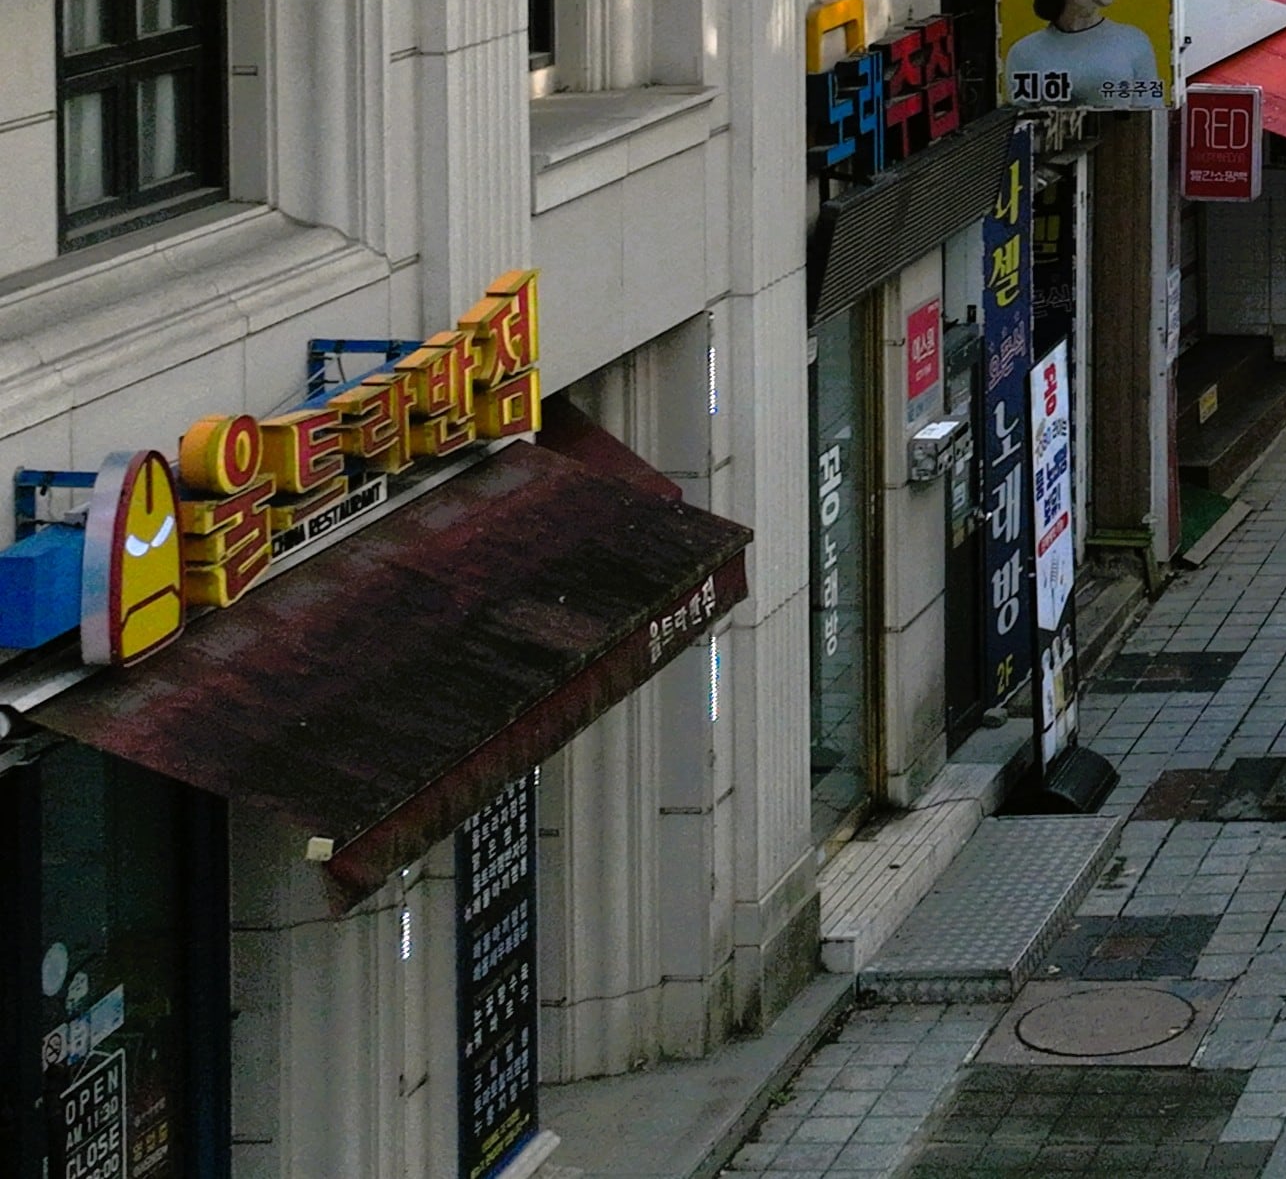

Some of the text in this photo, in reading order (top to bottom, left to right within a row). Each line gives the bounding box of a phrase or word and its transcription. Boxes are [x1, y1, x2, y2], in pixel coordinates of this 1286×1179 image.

[1012, 72, 1165, 101] 지하 유흥주점
[1190, 107, 1250, 150] RED
[195, 269, 541, 608] 울트라반점
[991, 401, 1024, 636] 노래방
[822, 530, 841, 657] 노래방
[996, 652, 1015, 697] 2F
[65, 1065, 119, 1126] OPEN
[65, 1122, 120, 1179] CLOSE
[66, 1123, 83, 1152] AM
